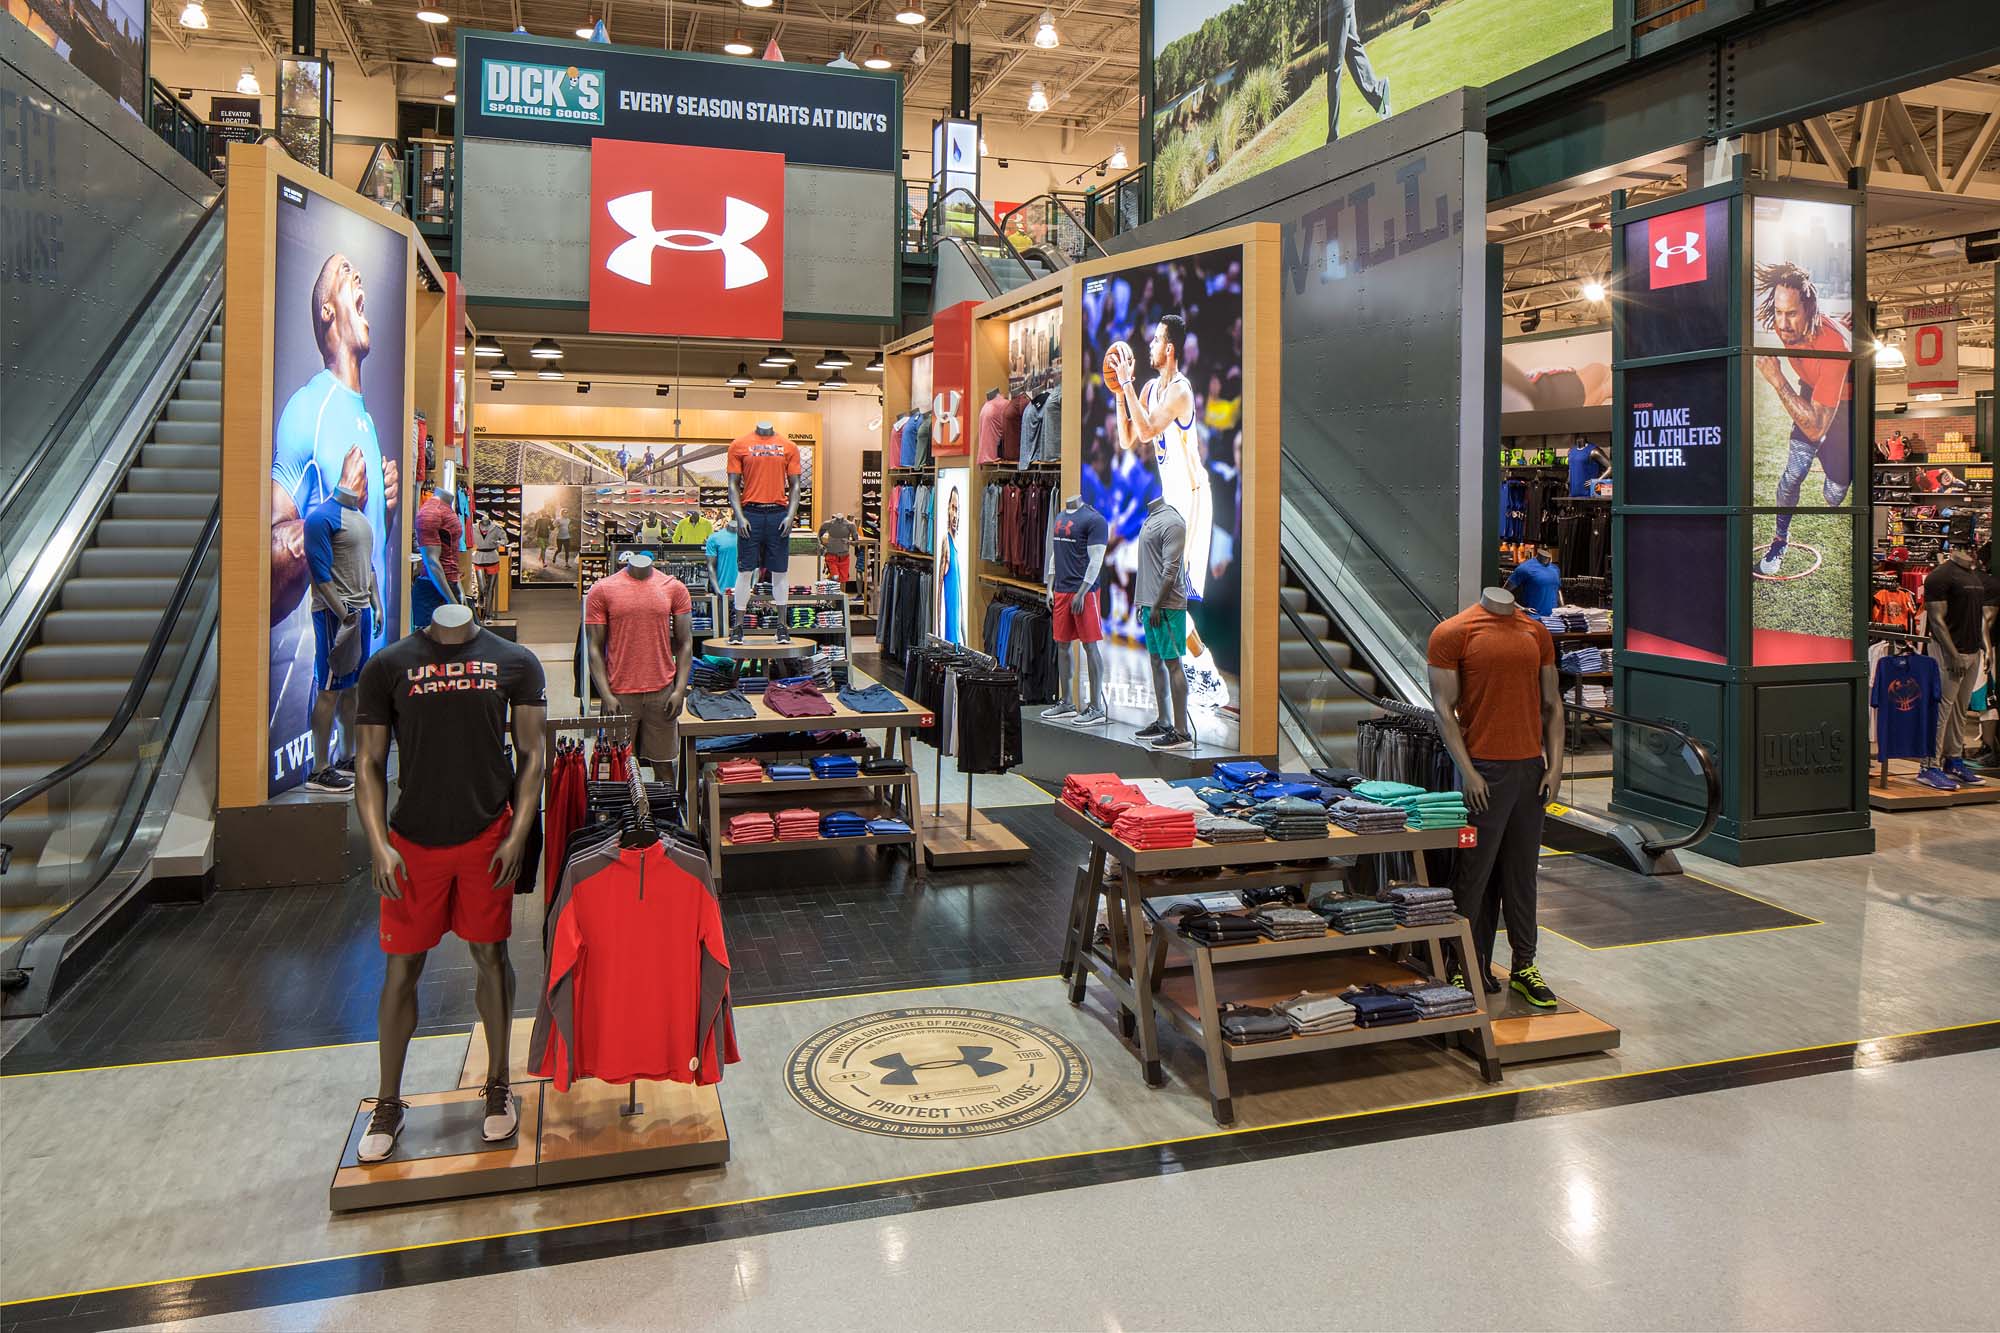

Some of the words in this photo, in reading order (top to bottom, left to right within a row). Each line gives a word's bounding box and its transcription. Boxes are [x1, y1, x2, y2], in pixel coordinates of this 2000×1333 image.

[488, 63, 600, 110] DICK'S
[220, 110, 251, 118] ELEVATOR
[489, 102, 552, 116] SPORTING
[620, 90, 674, 114] EVERY
[676, 95, 743, 120] SEASON
[746, 101, 810, 126] STARTS
[812, 108, 834, 128] AT
[836, 109, 888, 133] DICK'S
[222, 117, 250, 125] LOCATED
[1633, 410, 1649, 428] TO
[1652, 407, 1690, 427] MAKE
[1634, 429, 1655, 448] ALL
[1658, 426, 1721, 447] ATHLETES
[1634, 448, 1686, 467] BETTER.
[407, 661, 499, 682] UNDER
[408, 678, 498, 697] ARMOUR
[274, 746, 285, 781] I
[827, 1036, 865, 1063] UNIVERSAL
[862, 1020, 924, 1039] GUARANTEE
[944, 1020, 1025, 1041] PERFORMANCE
[799, 1088, 828, 1108] VERSUS
[823, 1106, 841, 1115] US
[867, 1099, 951, 1118] PROTECT
[955, 1102, 995, 1117] THIS
[882, 1123, 899, 1132] US
[903, 1126, 944, 1134] KNOCK
[948, 1126, 963, 1134] TO
